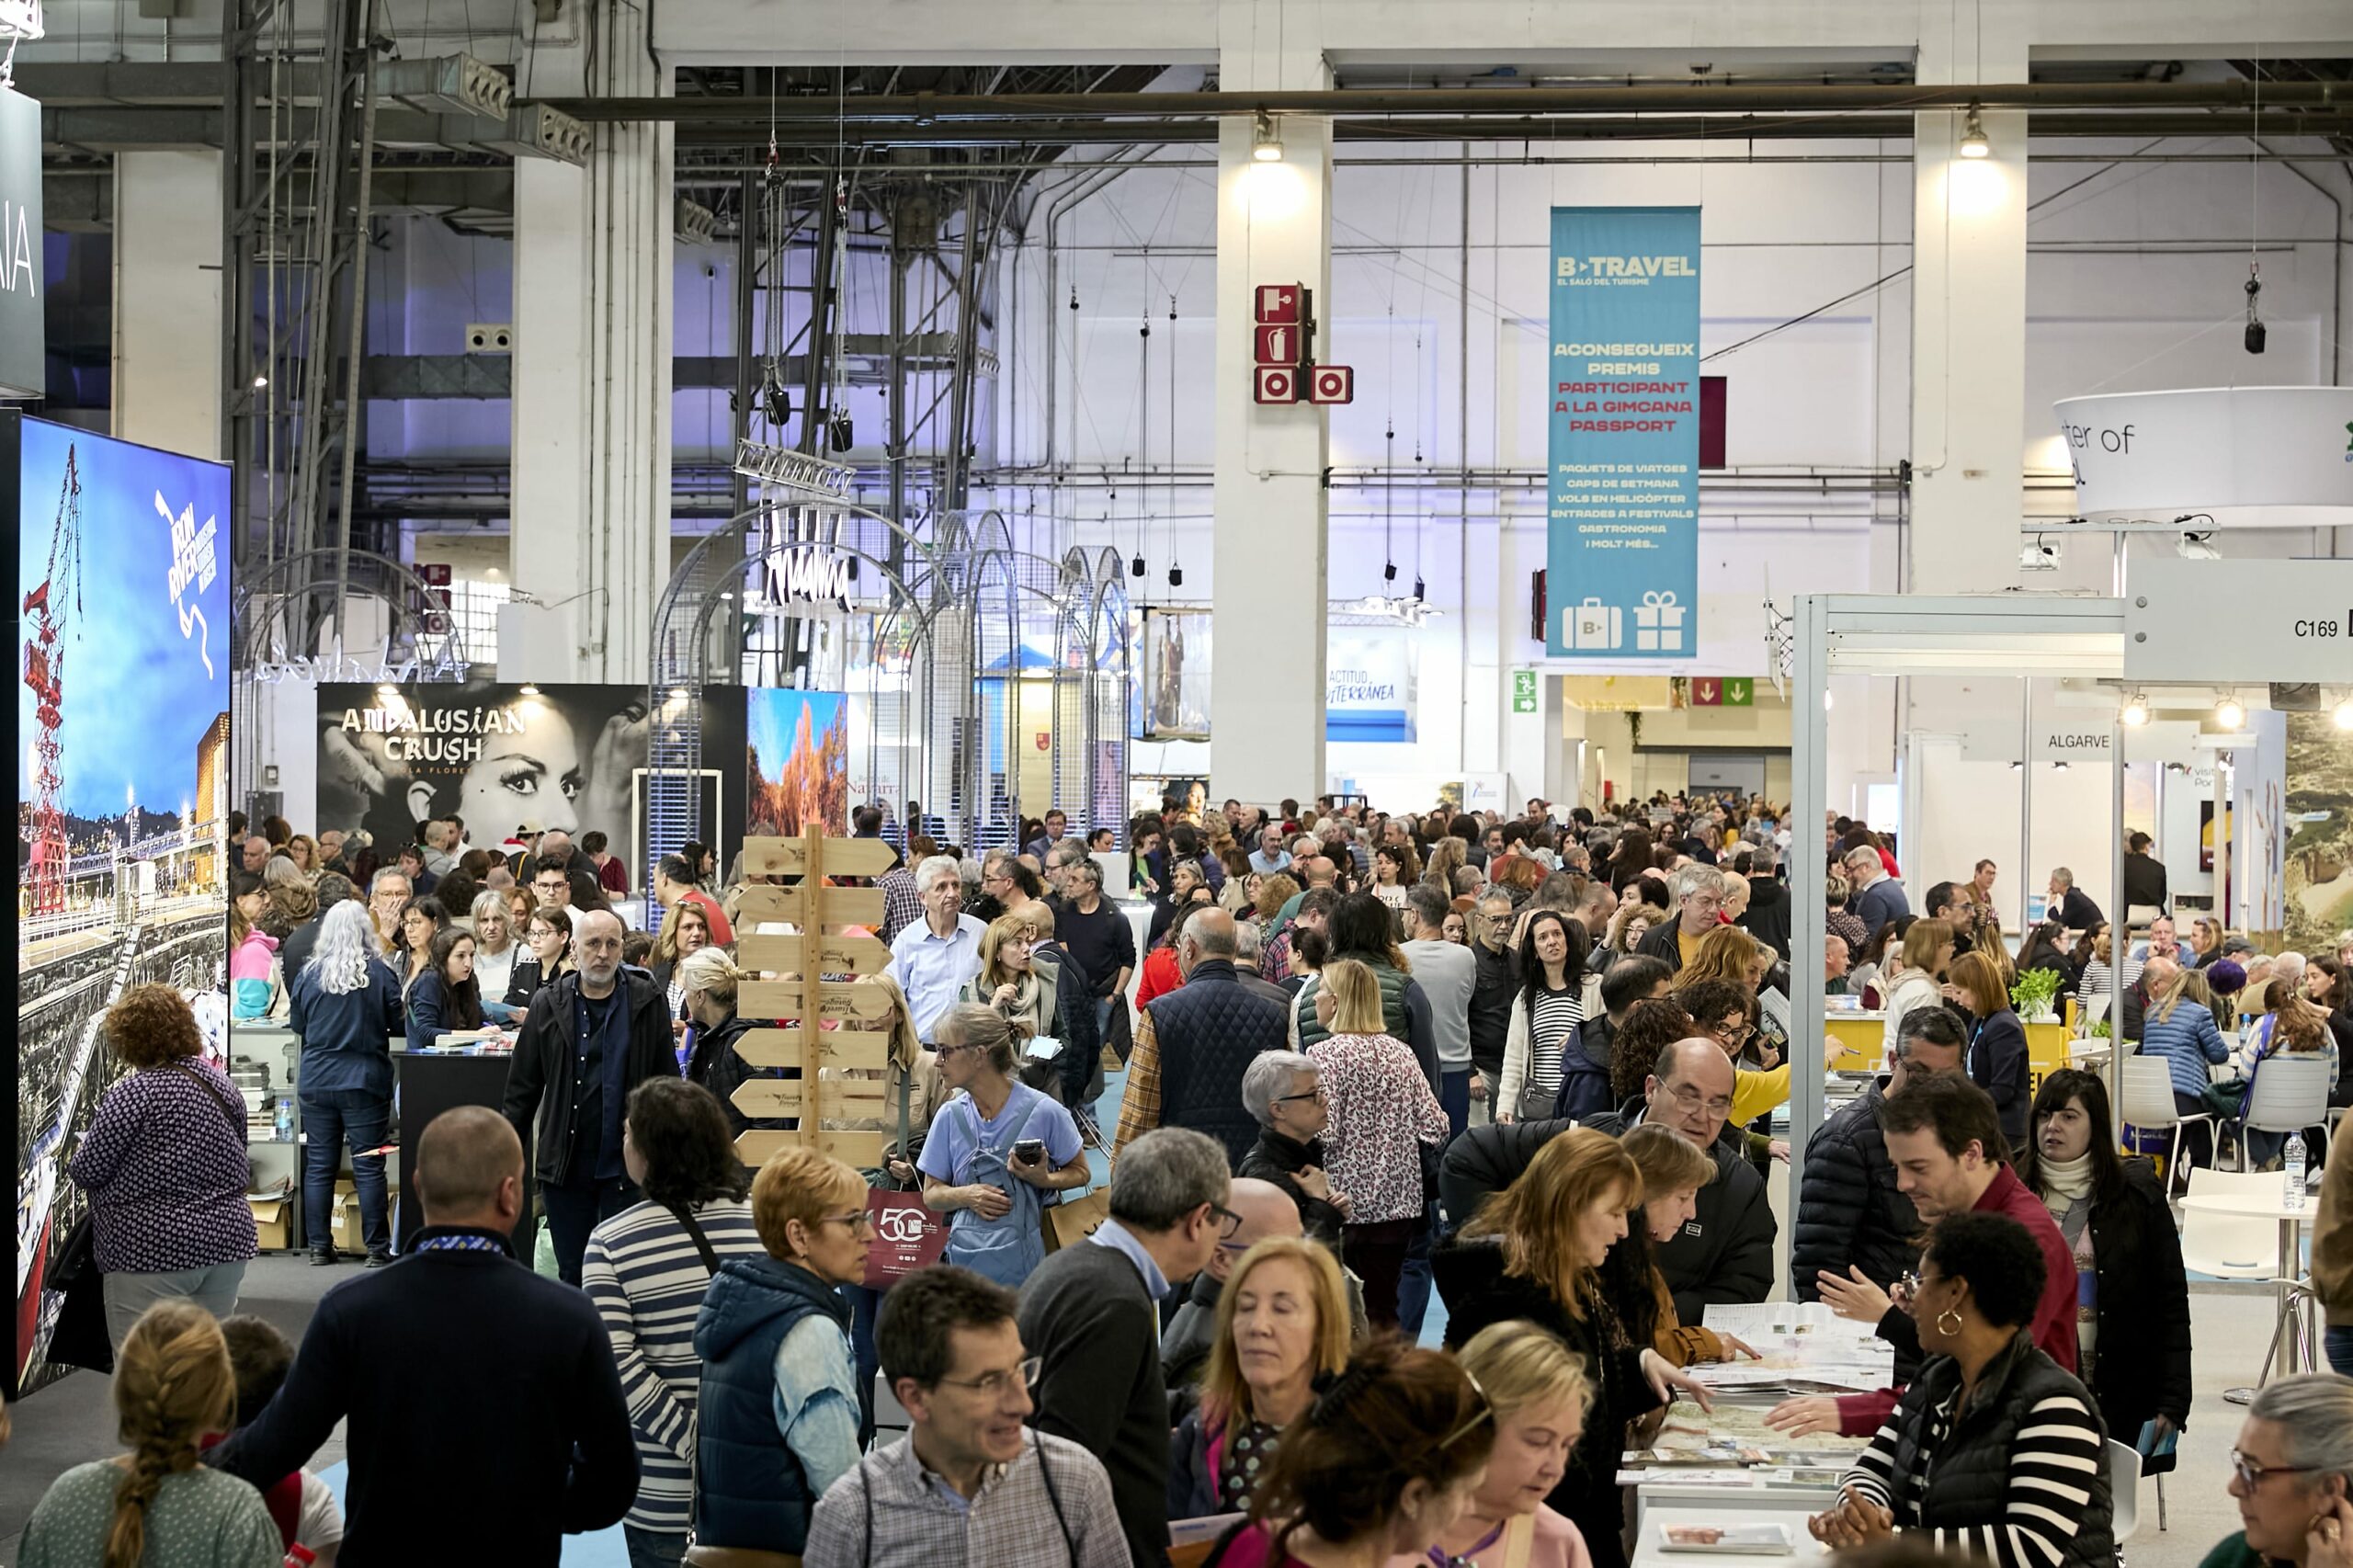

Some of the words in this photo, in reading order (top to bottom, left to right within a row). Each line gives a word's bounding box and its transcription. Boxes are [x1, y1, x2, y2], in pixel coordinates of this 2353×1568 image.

[1569, 278, 1592, 286] SALÓ
[1612, 278, 1649, 286] TURISME
[1553, 344, 1695, 356] ACONSEGUEIX
[1587, 363, 1661, 375] PREMIS
[1558, 382, 1689, 393] PARTICIPANT
[1554, 402, 1568, 413] A
[1573, 402, 1597, 413] LA
[1602, 402, 1693, 413] GIMCANA
[1570, 420, 1677, 432] PASSPORT
[2101, 425, 2135, 454] of
[1559, 464, 1615, 473] PAQUETS
[1617, 464, 1633, 472] DE
[1636, 464, 1688, 473] VIATGES
[1566, 480, 1600, 488] CAPS
[1602, 480, 1619, 488] DE
[1620, 480, 1680, 488] SETMANA
[1558, 494, 1589, 503] VOLS
[1591, 494, 1608, 503] EN
[1551, 510, 1616, 518] ENTRADES
[1629, 510, 1694, 518] FESTIVALS
[1578, 525, 1666, 533] GASTRONOMIA
[2294, 619, 2337, 637] C169
[1329, 669, 1368, 684] ACTITUD
[2049, 734, 2109, 748] ALGARVE
